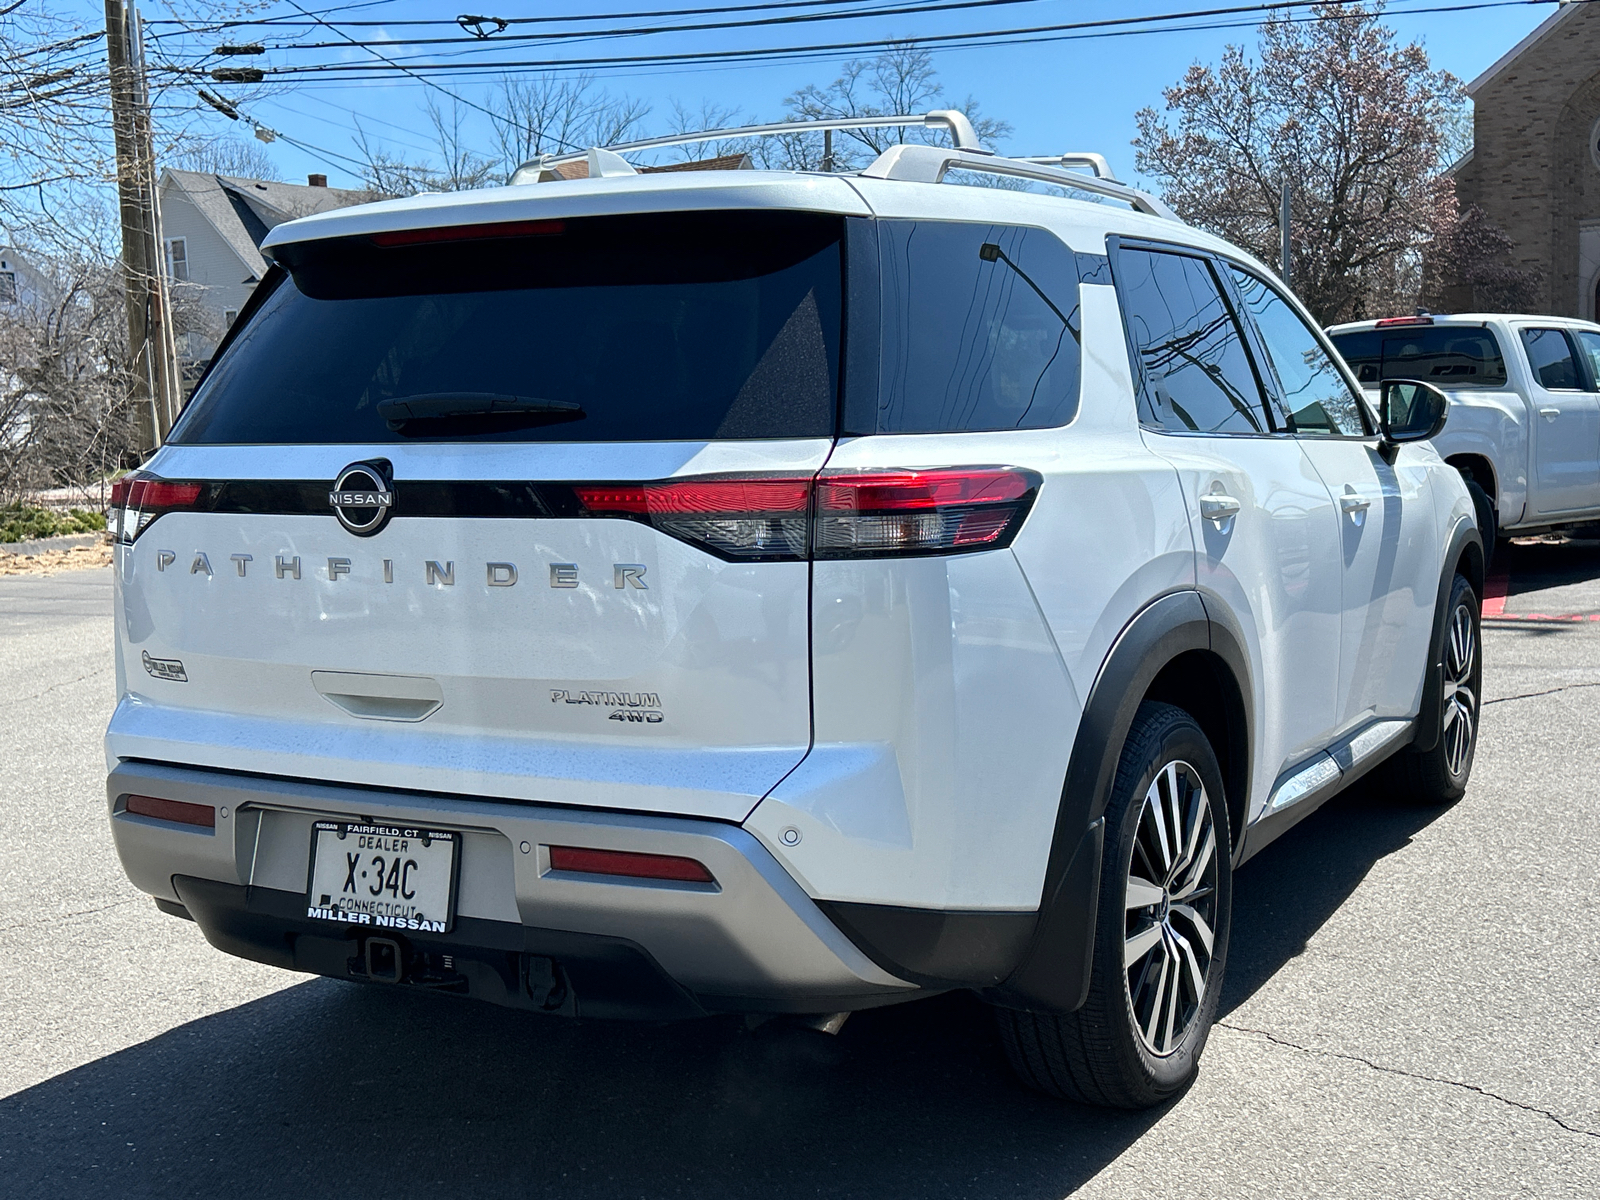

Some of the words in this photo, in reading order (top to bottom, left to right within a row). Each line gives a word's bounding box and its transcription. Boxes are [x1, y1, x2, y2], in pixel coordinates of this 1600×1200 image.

[329, 494, 390, 504] NISSAN
[156, 549, 649, 590] PATHFINDER
[550, 689, 662, 707] PLATINUM
[608, 709, 664, 723] 4WD
[347, 825, 402, 837] FAIRFIELD,
[404, 829, 419, 837] CT
[358, 836, 409, 852] DEALER
[338, 897, 417, 917] CONNECTICUT
[307, 908, 371, 924] MILLER
[376, 915, 446, 933] NISSAN
